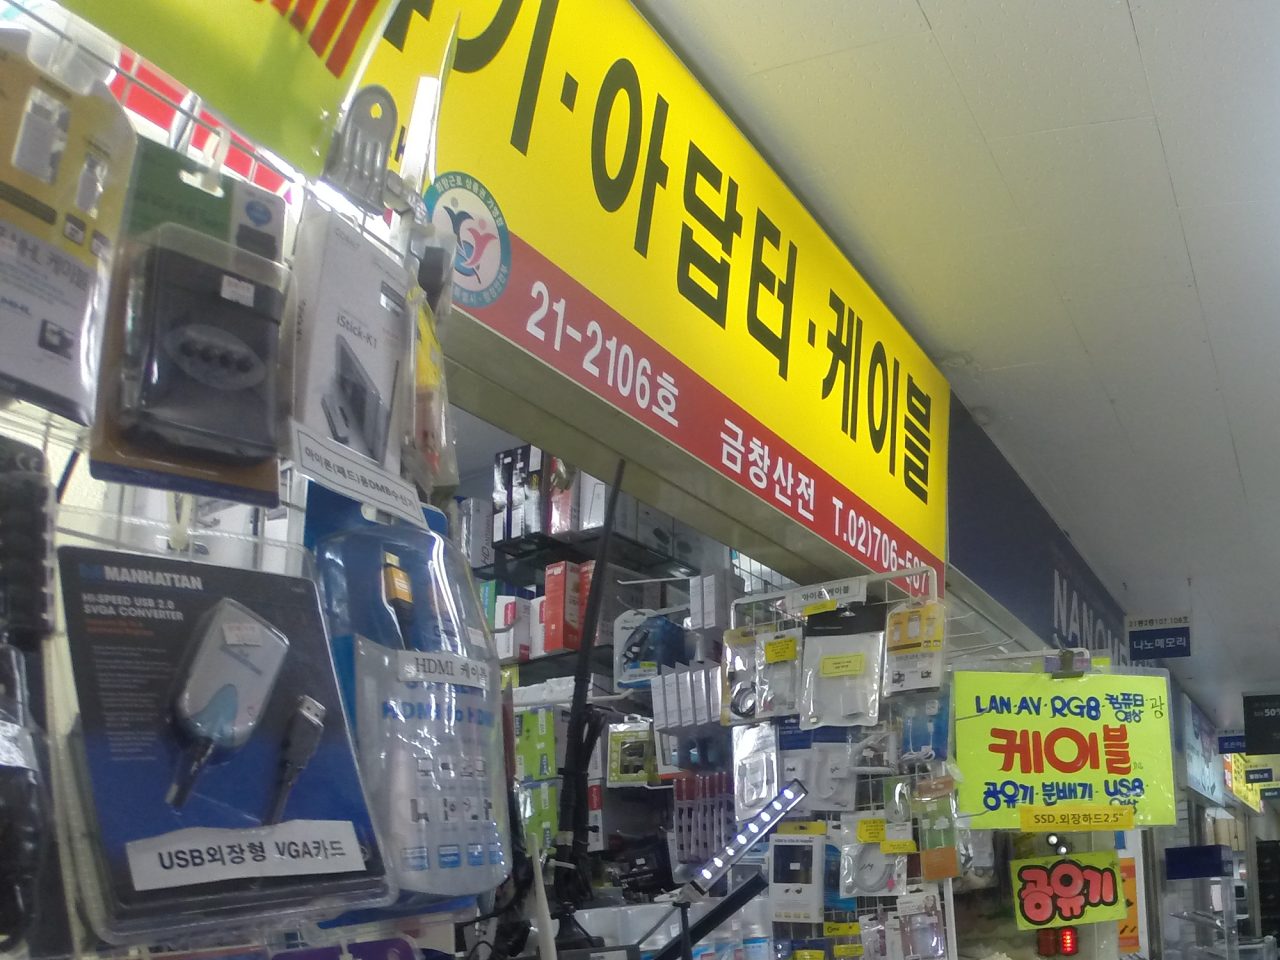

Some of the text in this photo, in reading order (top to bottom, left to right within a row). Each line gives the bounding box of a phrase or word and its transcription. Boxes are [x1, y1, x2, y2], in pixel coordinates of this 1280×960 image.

[526, 280, 680, 429] 21-2106호
[719, 418, 816, 522] 금창산전
[104, 565, 203, 591] MANHATTAN
[1133, 636, 1187, 651] 나노메모리
[415, 657, 455, 677] HDMI
[983, 780, 1034, 811] 공유기
[1042, 781, 1094, 806] 분배기
[158, 838, 346, 870] USB외장형 VGA카드
[1017, 859, 1118, 925] 공유기
